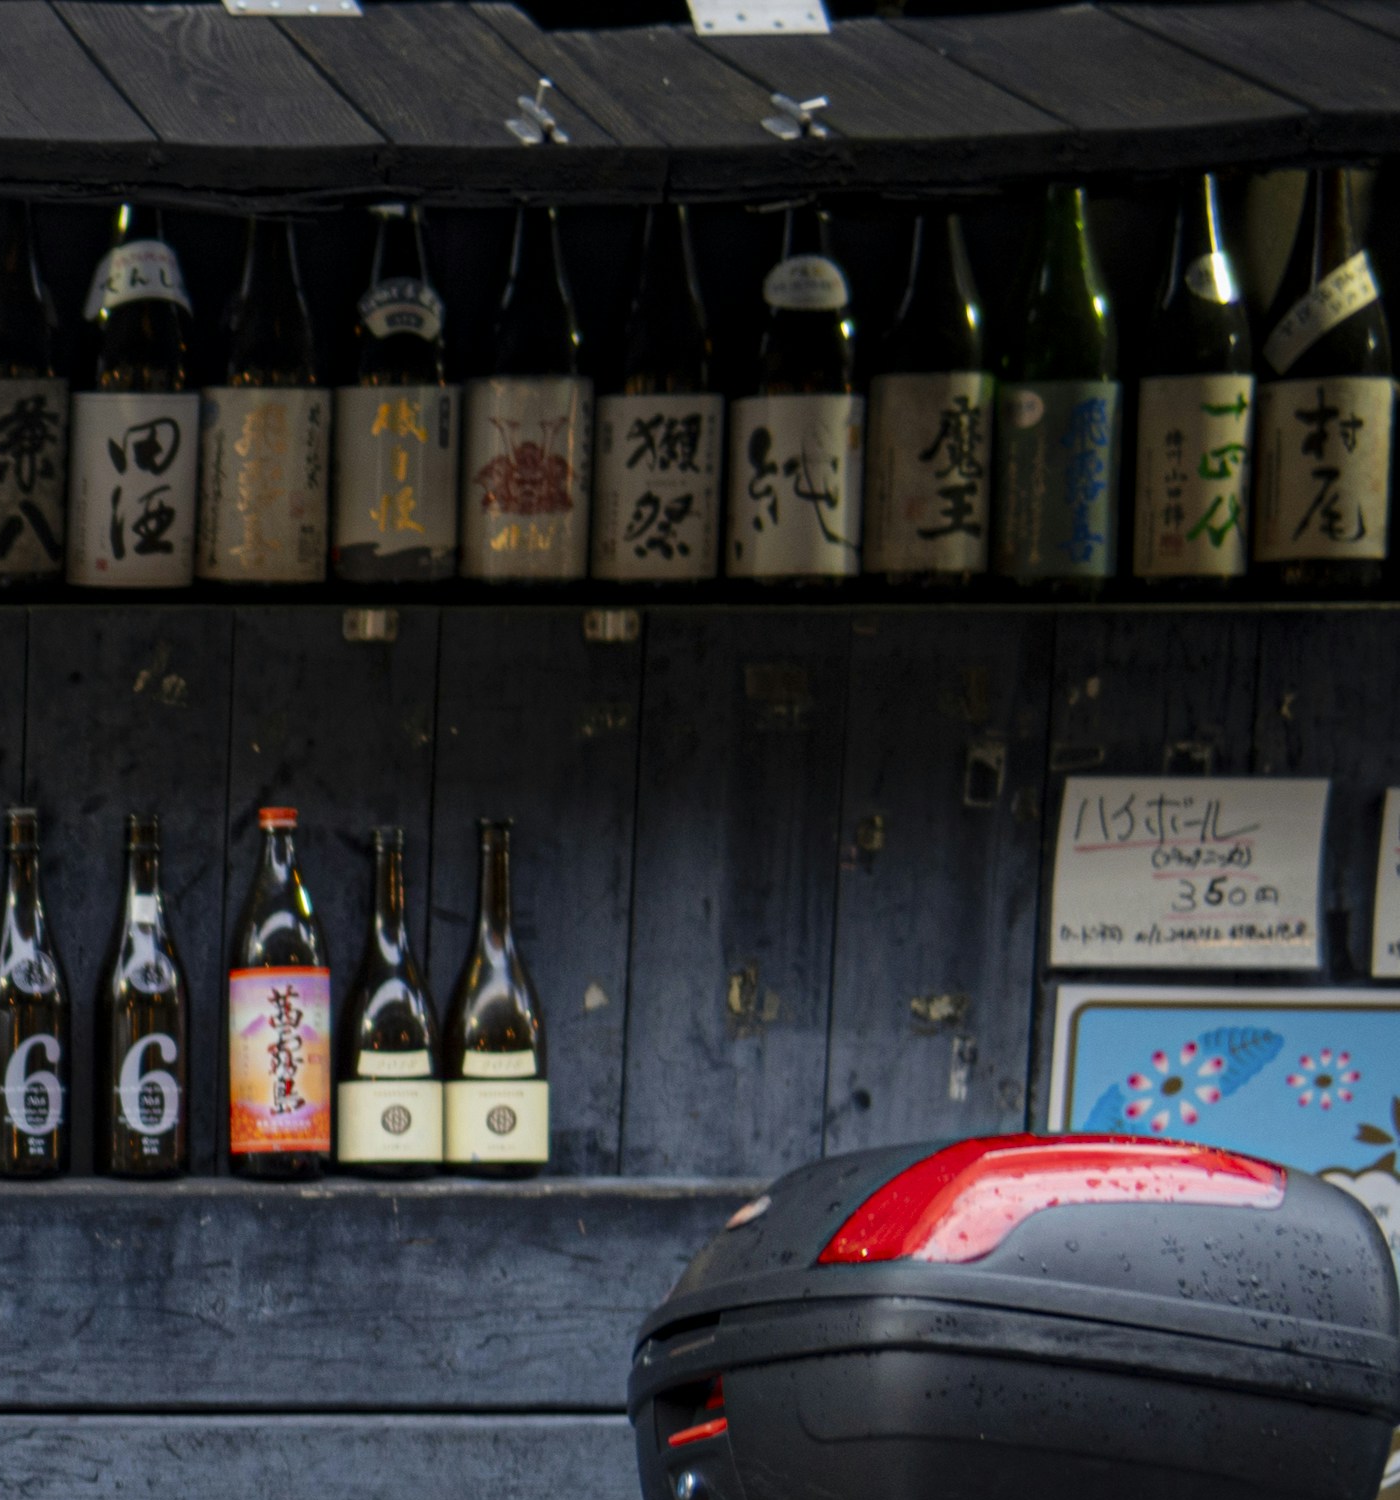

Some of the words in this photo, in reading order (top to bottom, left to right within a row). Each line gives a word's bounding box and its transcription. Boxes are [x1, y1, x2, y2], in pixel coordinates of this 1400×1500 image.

[109, 417, 181, 561] 田酒
[624, 413, 700, 560] 獺祭
[918, 396, 982, 541] 魔王
[1293, 386, 1364, 544] 村尾
[1074, 792, 1260, 843] ハイボール
[4, 1032, 62, 1135] 6
[119, 1032, 179, 1135] 6
